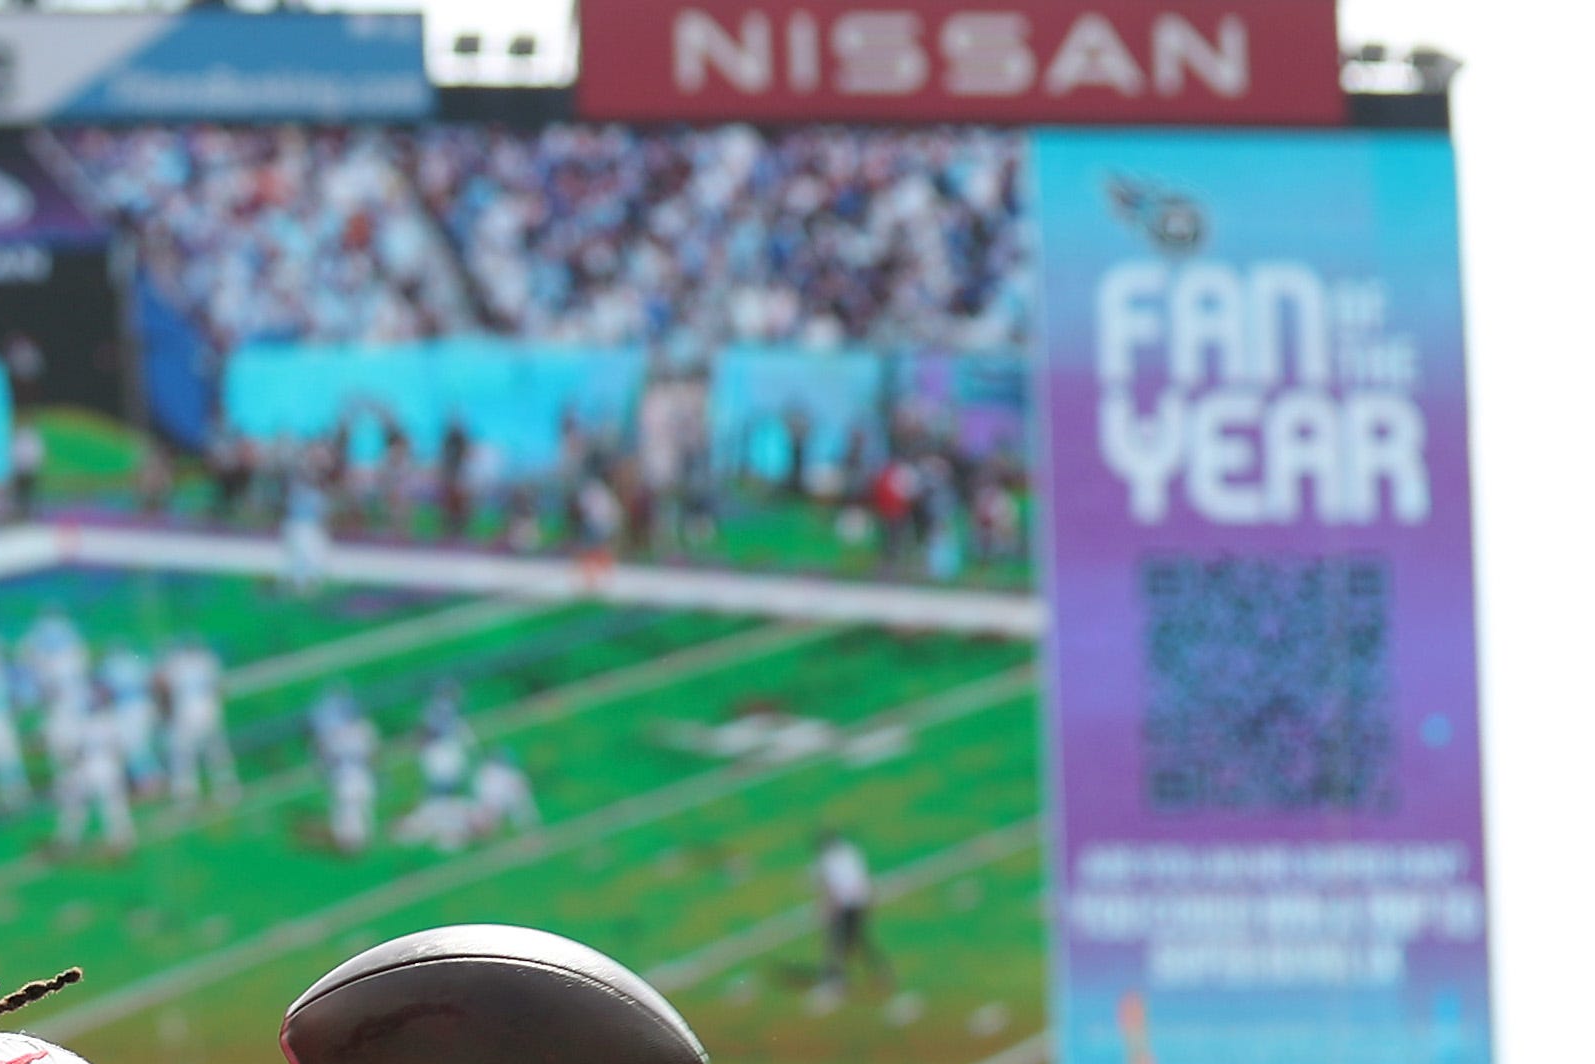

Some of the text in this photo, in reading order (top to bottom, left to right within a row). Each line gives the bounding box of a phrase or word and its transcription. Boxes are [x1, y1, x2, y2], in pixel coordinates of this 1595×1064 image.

[671, 11, 1249, 96] NISSAN
[1098, 262, 1330, 382] FAN
[1098, 382, 1433, 526] YEAR
